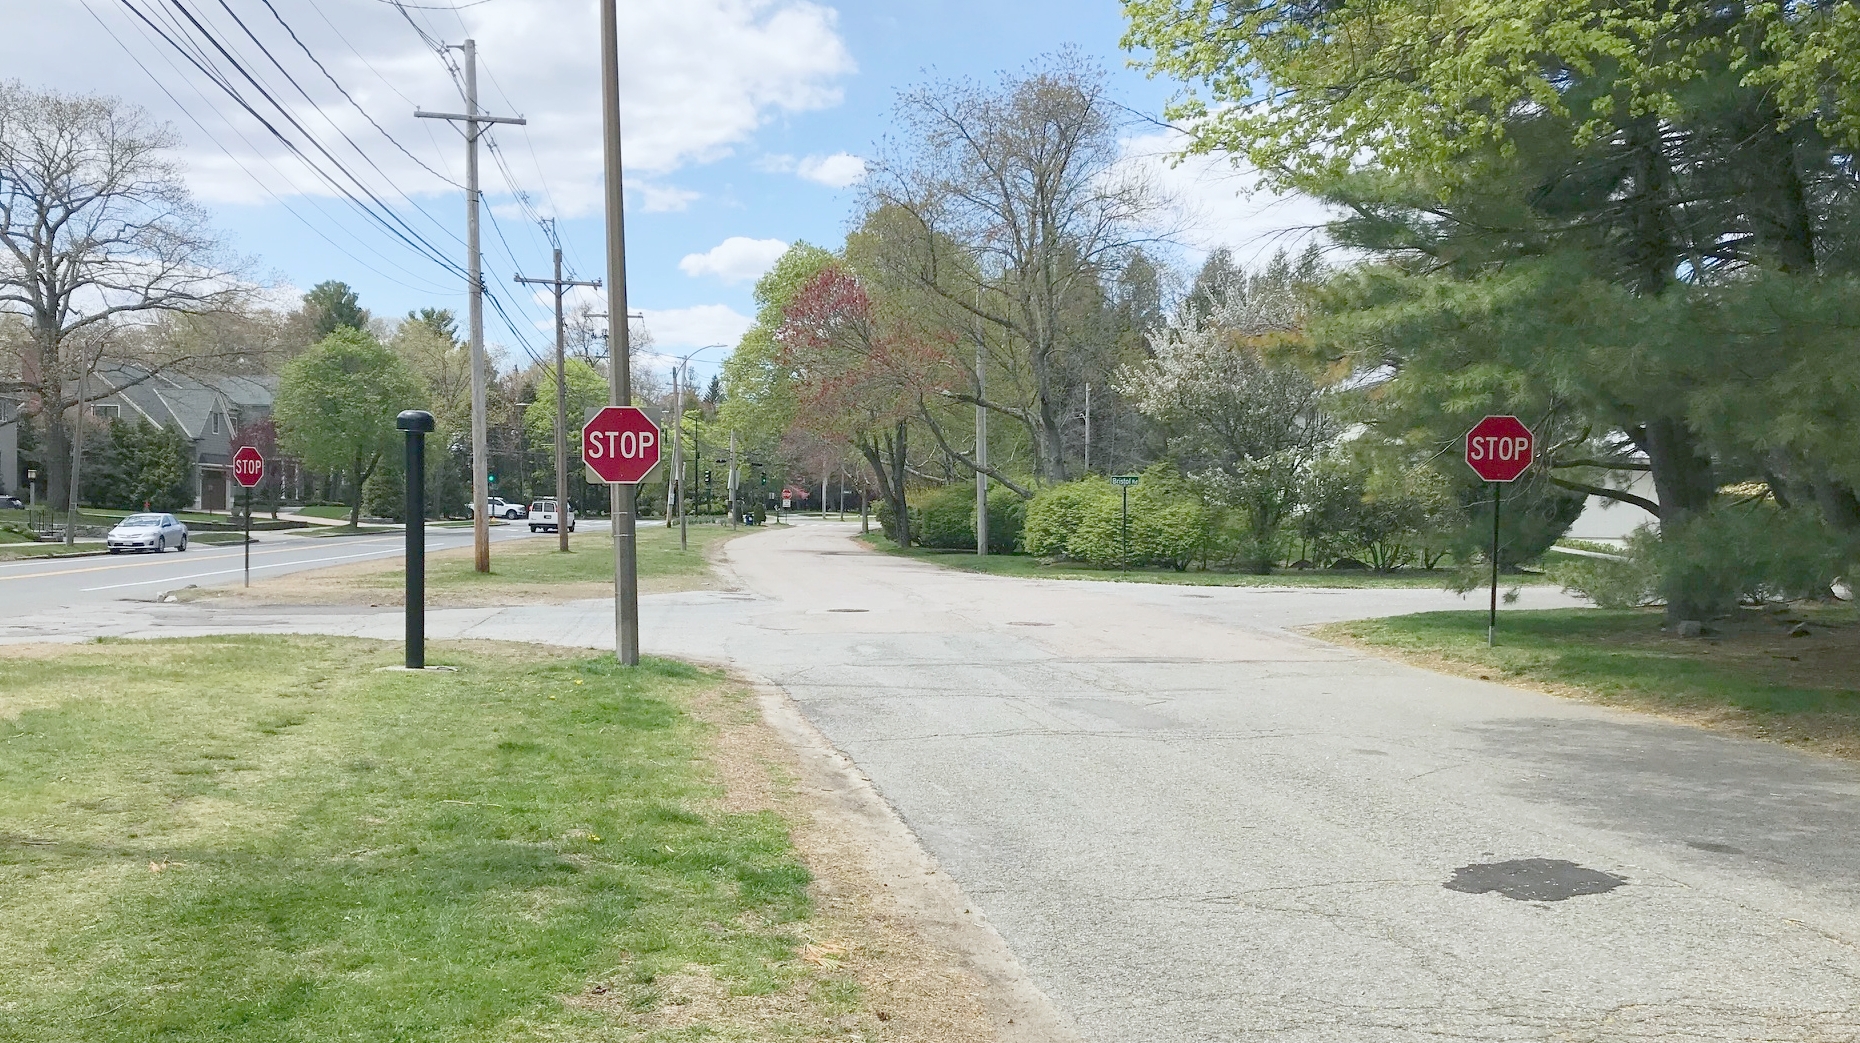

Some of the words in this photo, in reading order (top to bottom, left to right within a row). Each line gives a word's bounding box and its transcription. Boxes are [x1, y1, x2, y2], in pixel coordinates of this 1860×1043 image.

[588, 431, 654, 458] STOP
[1470, 436, 1529, 460] STOP
[235, 459, 262, 474] STOP
